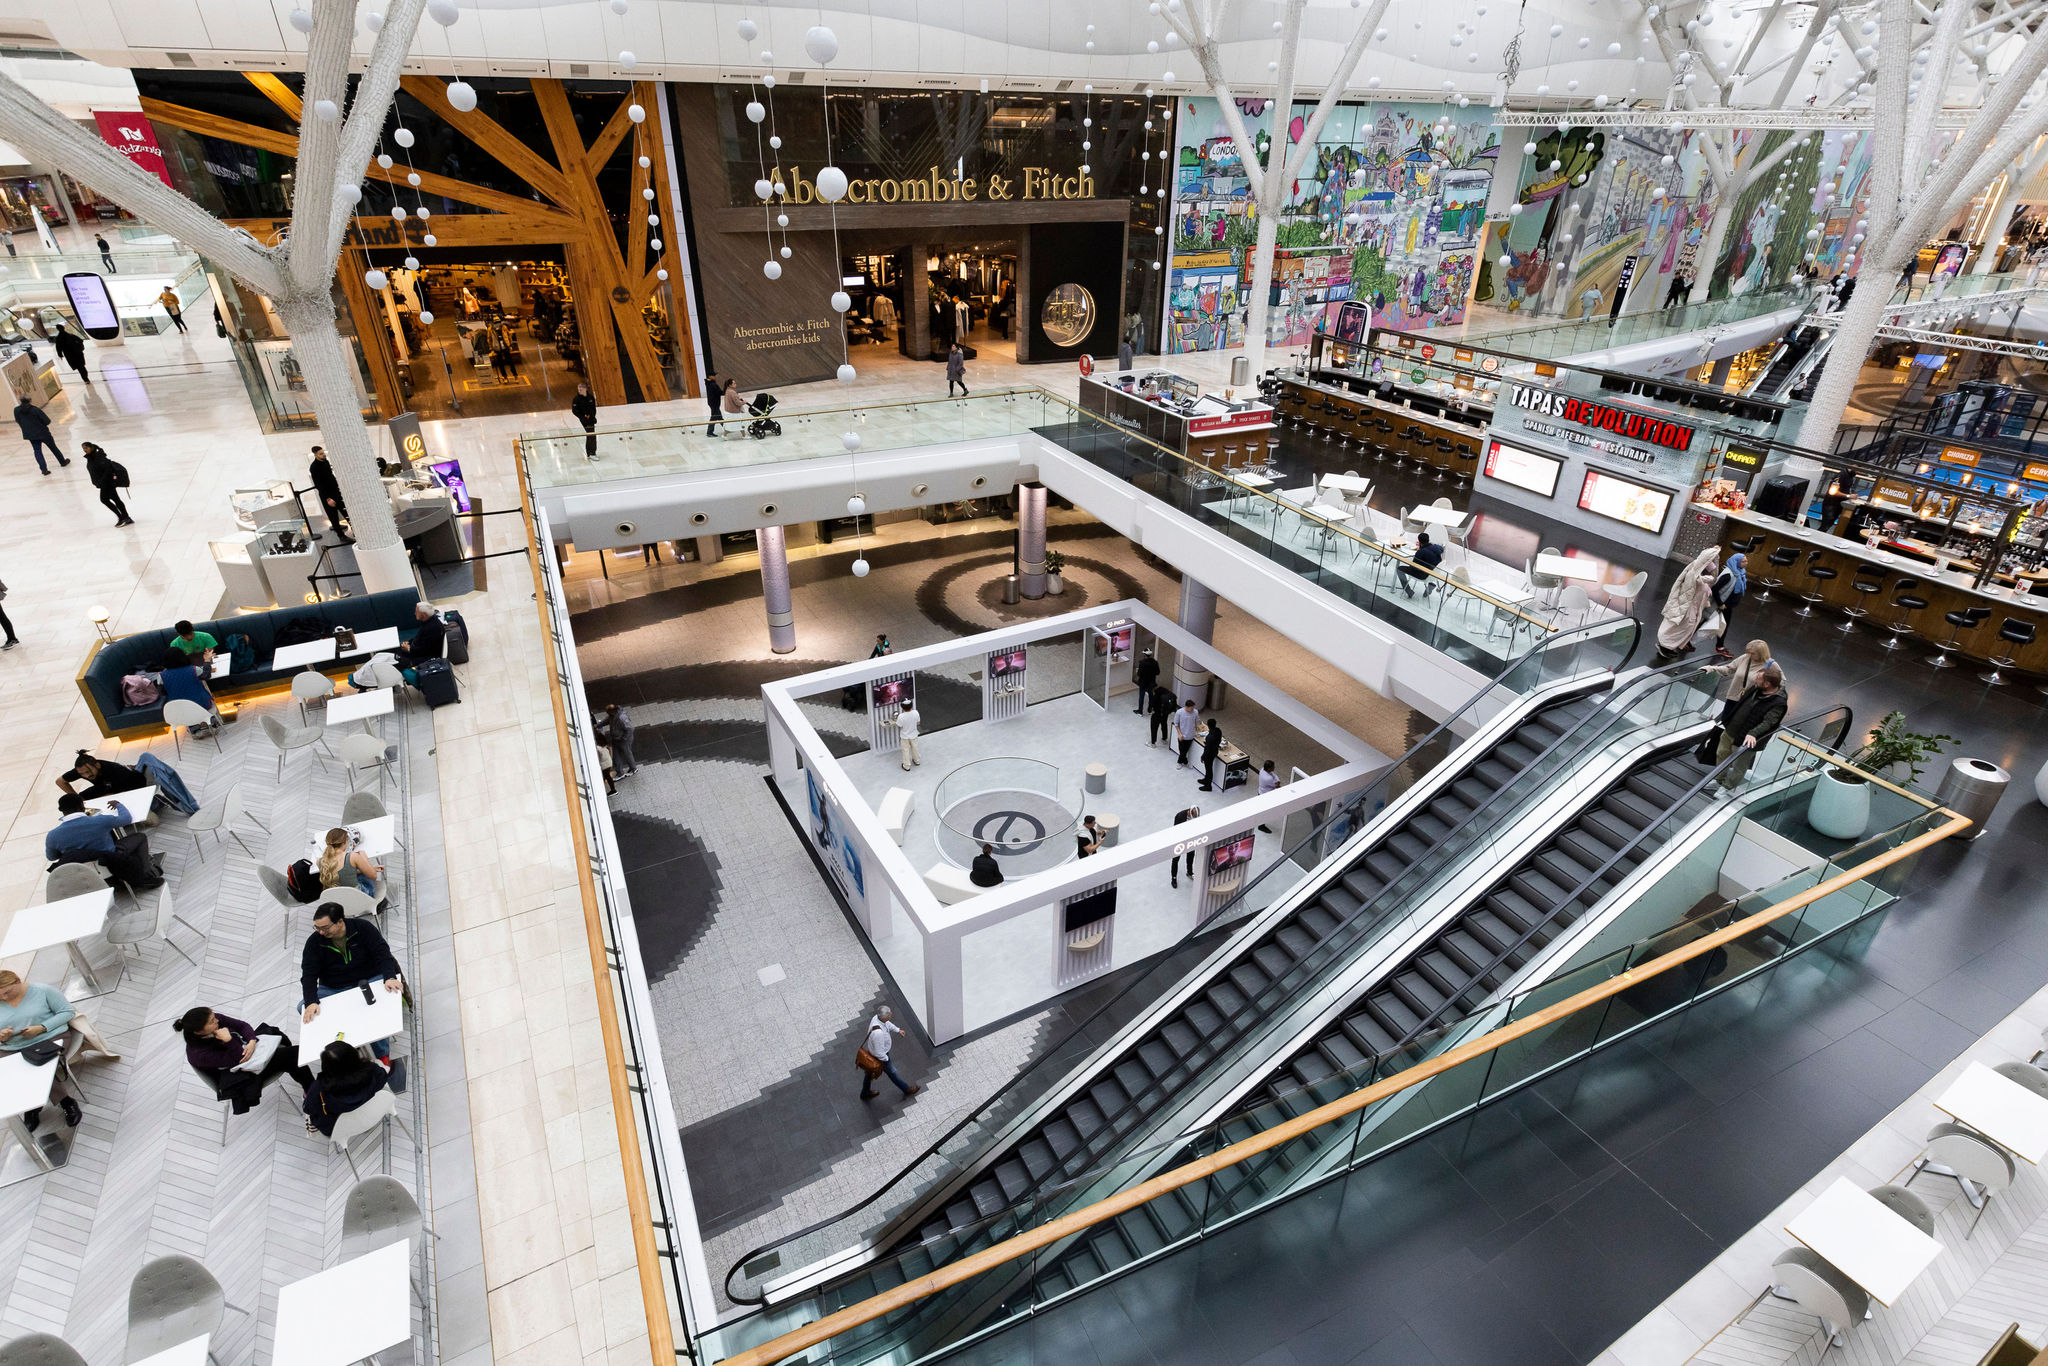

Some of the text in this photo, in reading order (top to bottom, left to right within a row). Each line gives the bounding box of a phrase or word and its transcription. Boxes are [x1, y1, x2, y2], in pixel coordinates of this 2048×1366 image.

[988, 174, 1013, 200] &
[1023, 165, 1096, 200] Fitch
[734, 318, 830, 338] Abercrombie & Fitch
[747, 333, 820, 351] abercrombie kids
[1511, 385, 1565, 418] TAPAS
[1564, 398, 1693, 450] REVOLUTION
[1525, 420, 1555, 434] SPANISH
[1575, 434, 1589, 446] BAR
[1600, 441, 1651, 462] RESTAURANT
[1486, 449, 1496, 469] TAPAS
[1946, 450, 1975, 461] CHORIZO
[1581, 479, 1593, 501] TAPAS
[1879, 486, 1909, 500] SANGRÍA
[1187, 835, 1209, 850] PICO
